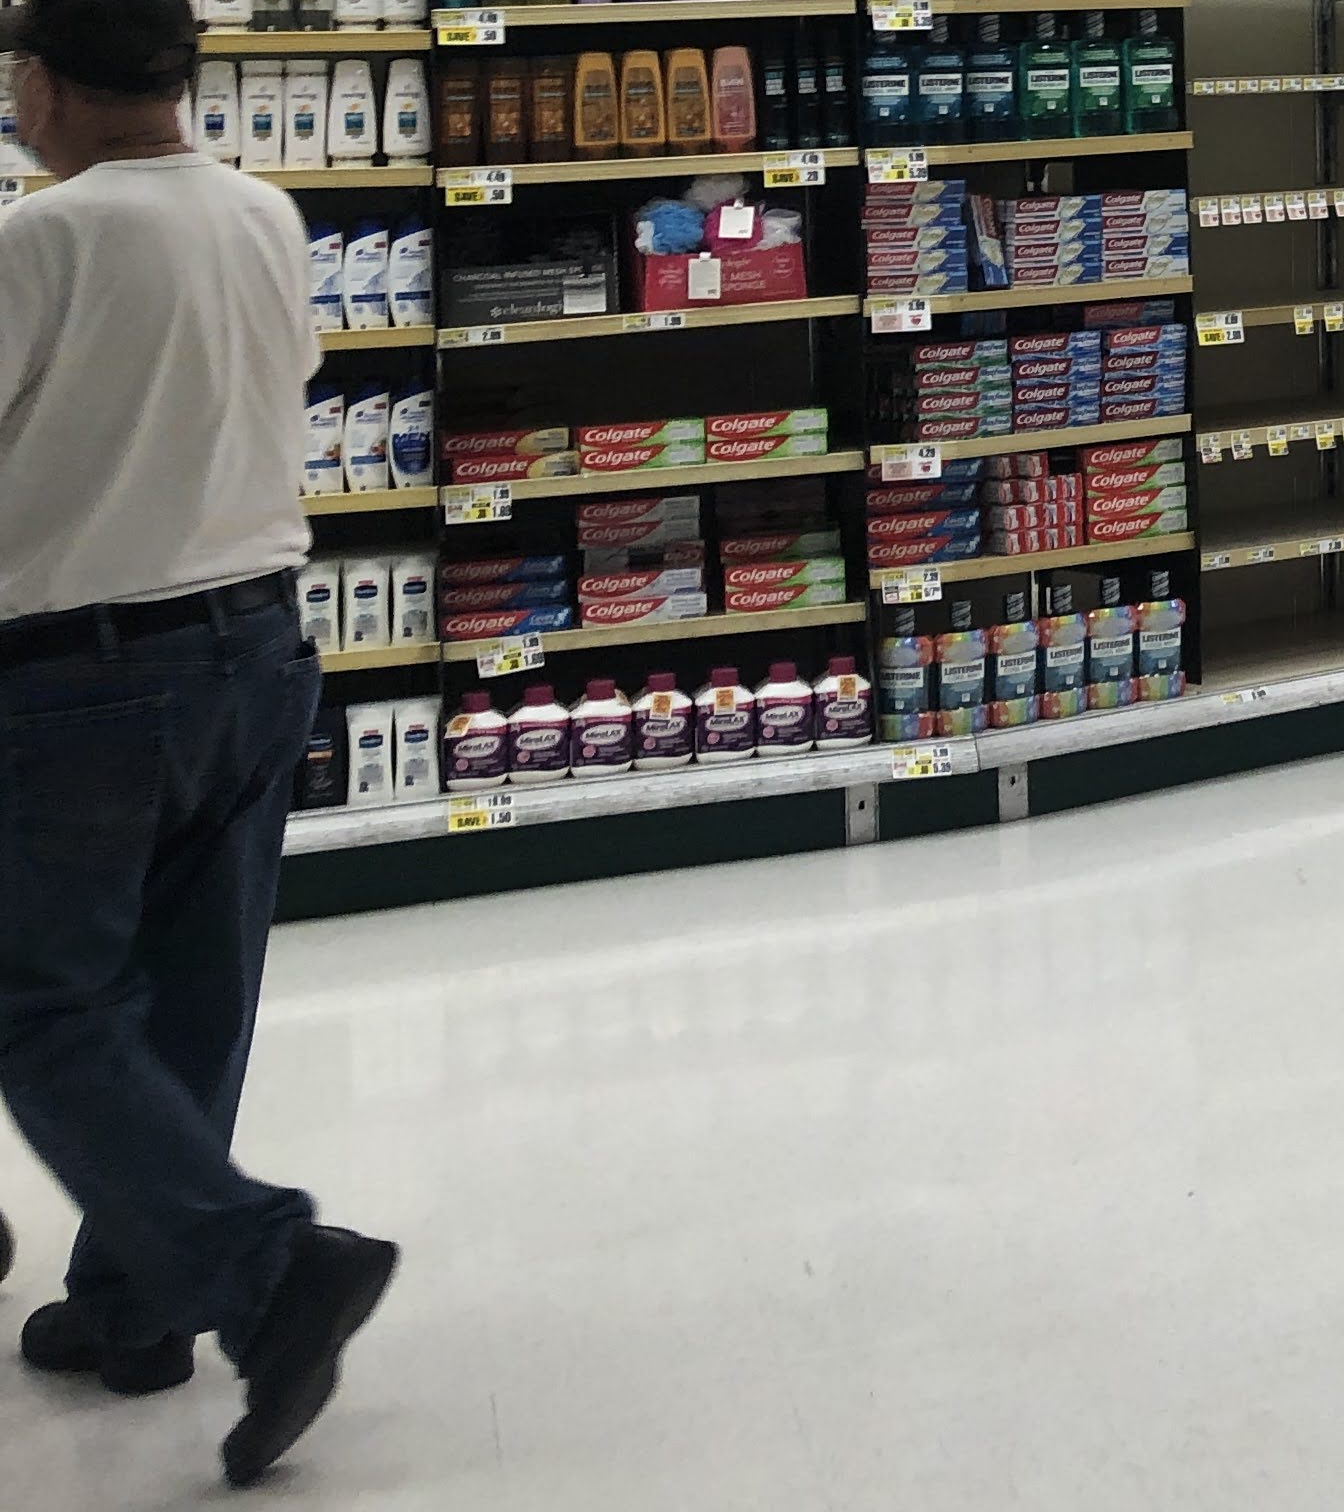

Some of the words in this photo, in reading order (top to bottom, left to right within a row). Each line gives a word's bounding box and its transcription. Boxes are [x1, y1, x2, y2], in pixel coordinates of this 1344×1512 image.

[919, 346, 970, 360] Colgate
[1015, 338, 1067, 352] Colgate
[584, 426, 652, 445] Colgate
[1091, 449, 1147, 465] Colgate
[457, 459, 529, 479] Colgate
[585, 601, 654, 620] Colgate
